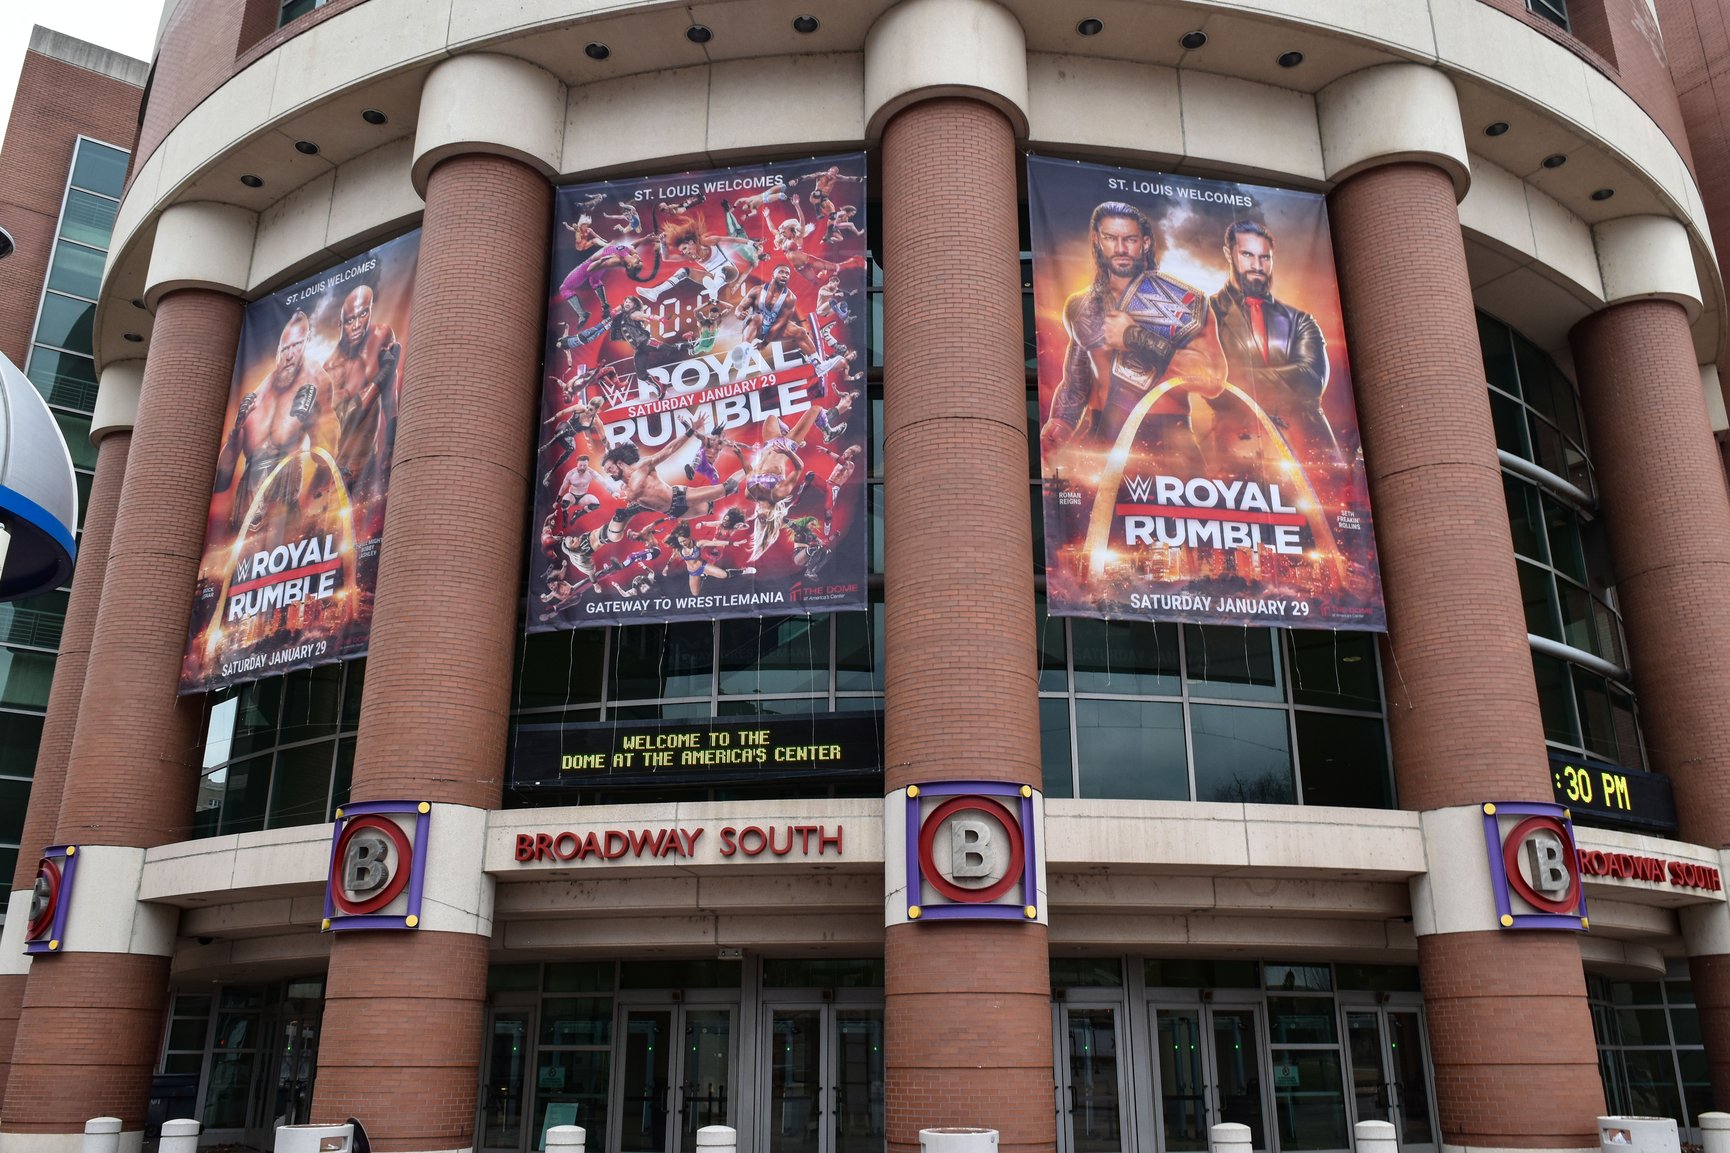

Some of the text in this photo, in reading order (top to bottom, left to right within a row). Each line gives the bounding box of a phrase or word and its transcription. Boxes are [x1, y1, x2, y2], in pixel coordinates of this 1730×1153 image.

[634, 174, 784, 201] ST. LOUIS WELCOMES
[1108, 178, 1252, 206] ST. LOUIS WELCOMES
[286, 259, 376, 305] ST. LOUIS WELCOMES
[638, 341, 804, 400] ROYAL
[604, 378, 812, 448] RUMBLE
[628, 374, 776, 418] SATURDAY JANUARY 29
[1155, 475, 1297, 514] ROYAL
[1124, 516, 1303, 555] RUMBLE
[251, 534, 339, 579] ROYAL
[228, 570, 336, 621] RUMBLE
[586, 591, 784, 614] GATEWAY TO WRESTLEMANIA
[826, 584, 858, 593] DOME
[1130, 593, 1309, 616] SATURDAY JANUARY 29
[222, 654, 267, 677] SATURDAY
[268, 644, 314, 665] JANUARY
[315, 640, 327, 656] 29
[562, 745, 841, 769] DOME AT THE AMERICA'S CENTER
[623, 730, 771, 750] WELCOME TO THE
[1555, 765, 1632, 811] :30 PM
[514, 824, 843, 862] BROADWAY SOUTH
[952, 820, 993, 878] B
[346, 838, 389, 890] B
[1526, 838, 1571, 892] B
[1576, 848, 1721, 891] ROADWAY SOUTH
